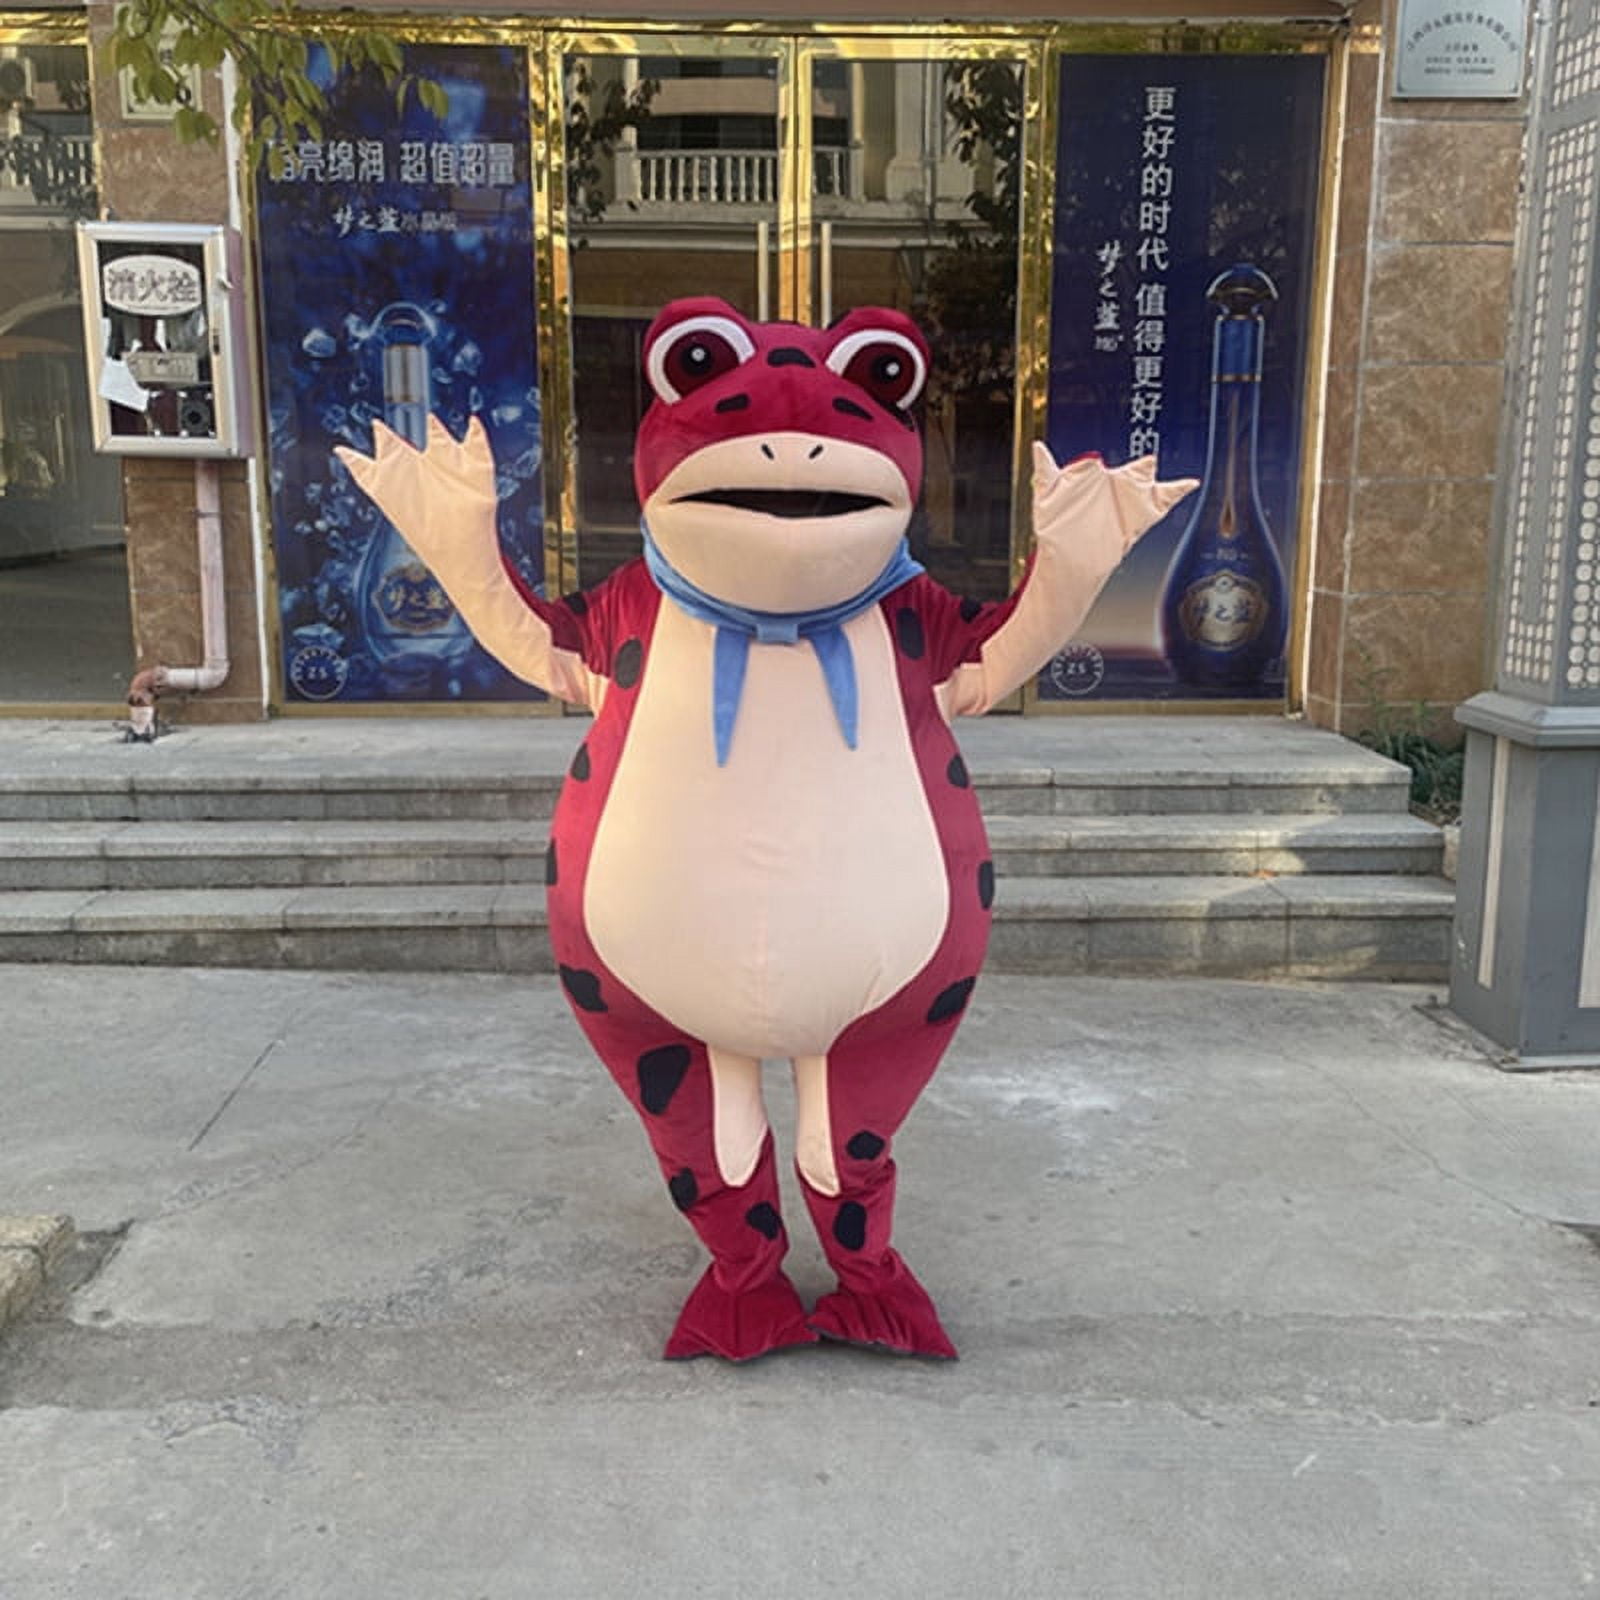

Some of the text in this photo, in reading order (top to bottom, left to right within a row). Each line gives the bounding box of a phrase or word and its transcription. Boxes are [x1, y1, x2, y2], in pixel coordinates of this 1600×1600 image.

[400, 141, 515, 186] 超值超量
[1129, 86, 1177, 458] 更好的时代 值得更好的
